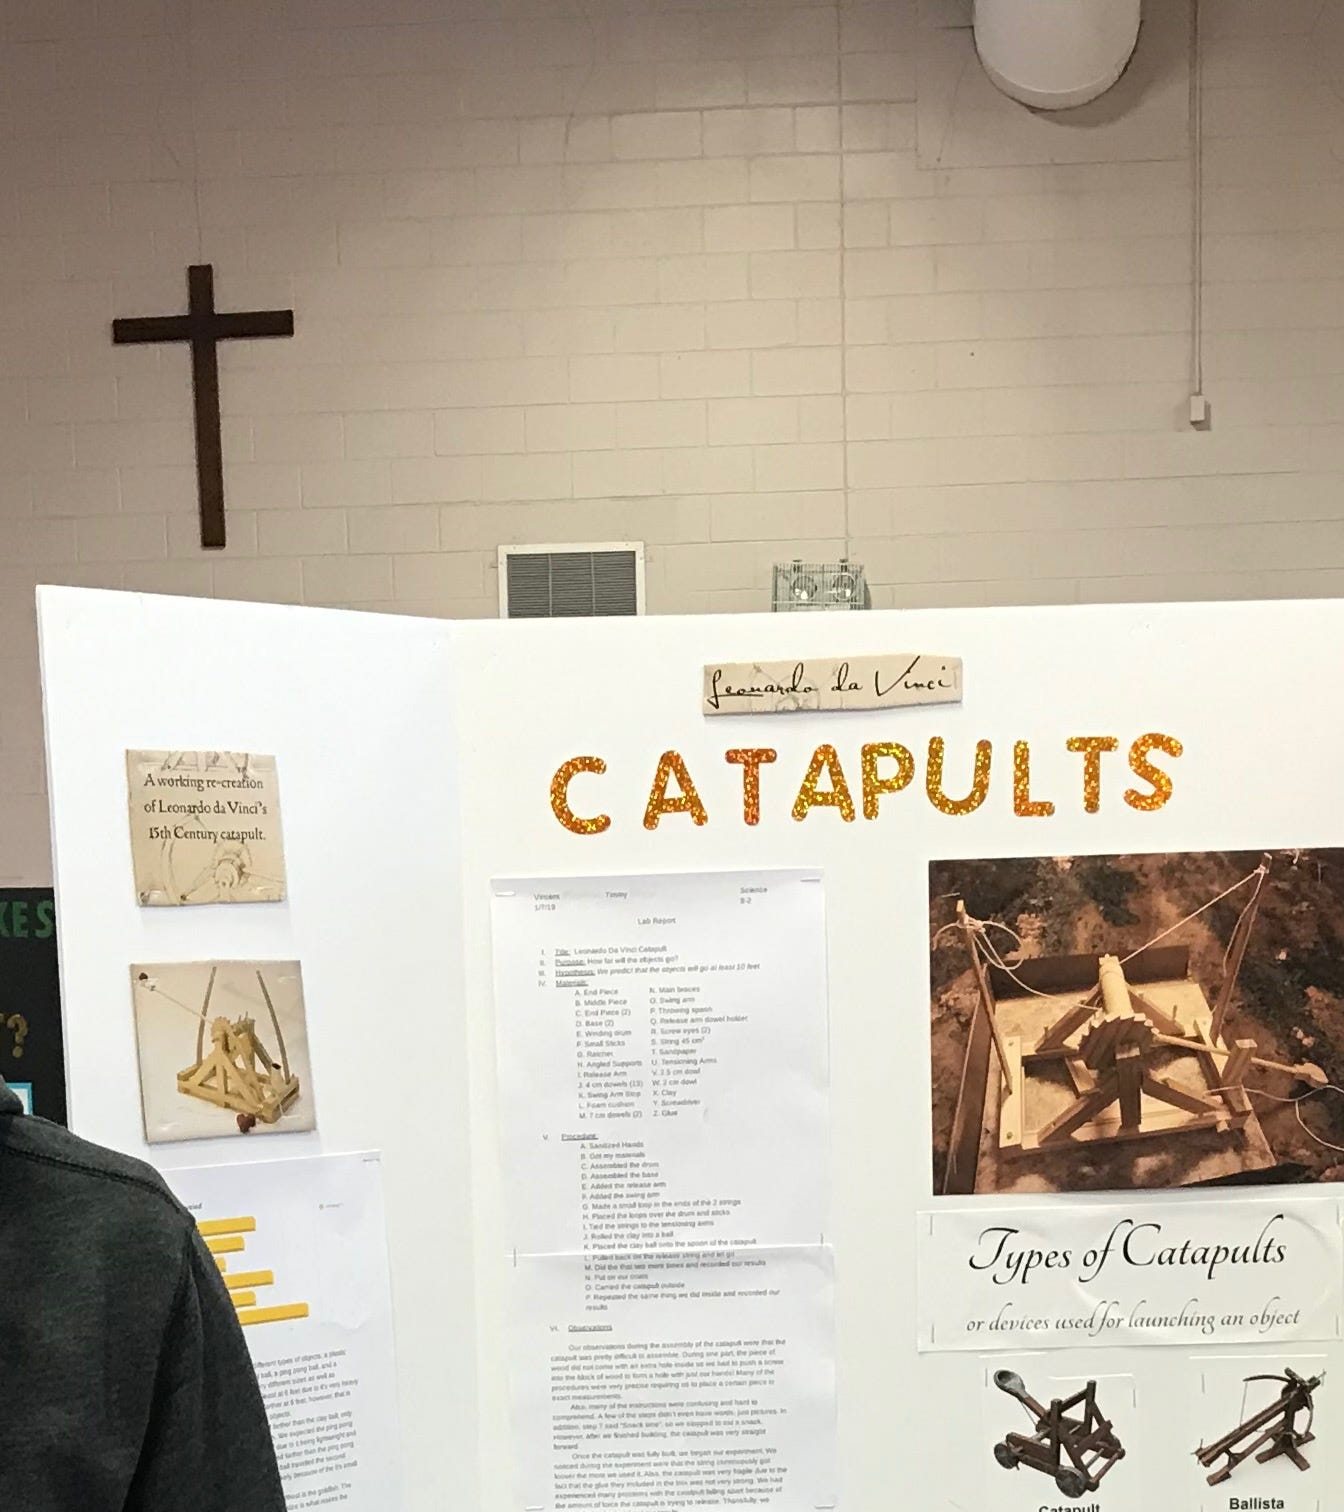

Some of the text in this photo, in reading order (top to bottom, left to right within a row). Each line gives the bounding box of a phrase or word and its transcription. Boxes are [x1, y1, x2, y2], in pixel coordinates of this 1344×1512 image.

[707, 656, 952, 709] Leonardo da Vinci
[144, 773, 263, 791] A working re-creation
[550, 732, 1184, 835] CATAPULTS
[144, 800, 267, 815] of Leonardo da Vinci's
[149, 826, 171, 840] 15th
[174, 825, 218, 842] Century
[637, 918, 651, 926] Lab
[968, 1213, 1287, 1285] Types of Catapults
[966, 1296, 1300, 1337] or devices used for launching an object
[1229, 1497, 1284, 1510] Ballista
